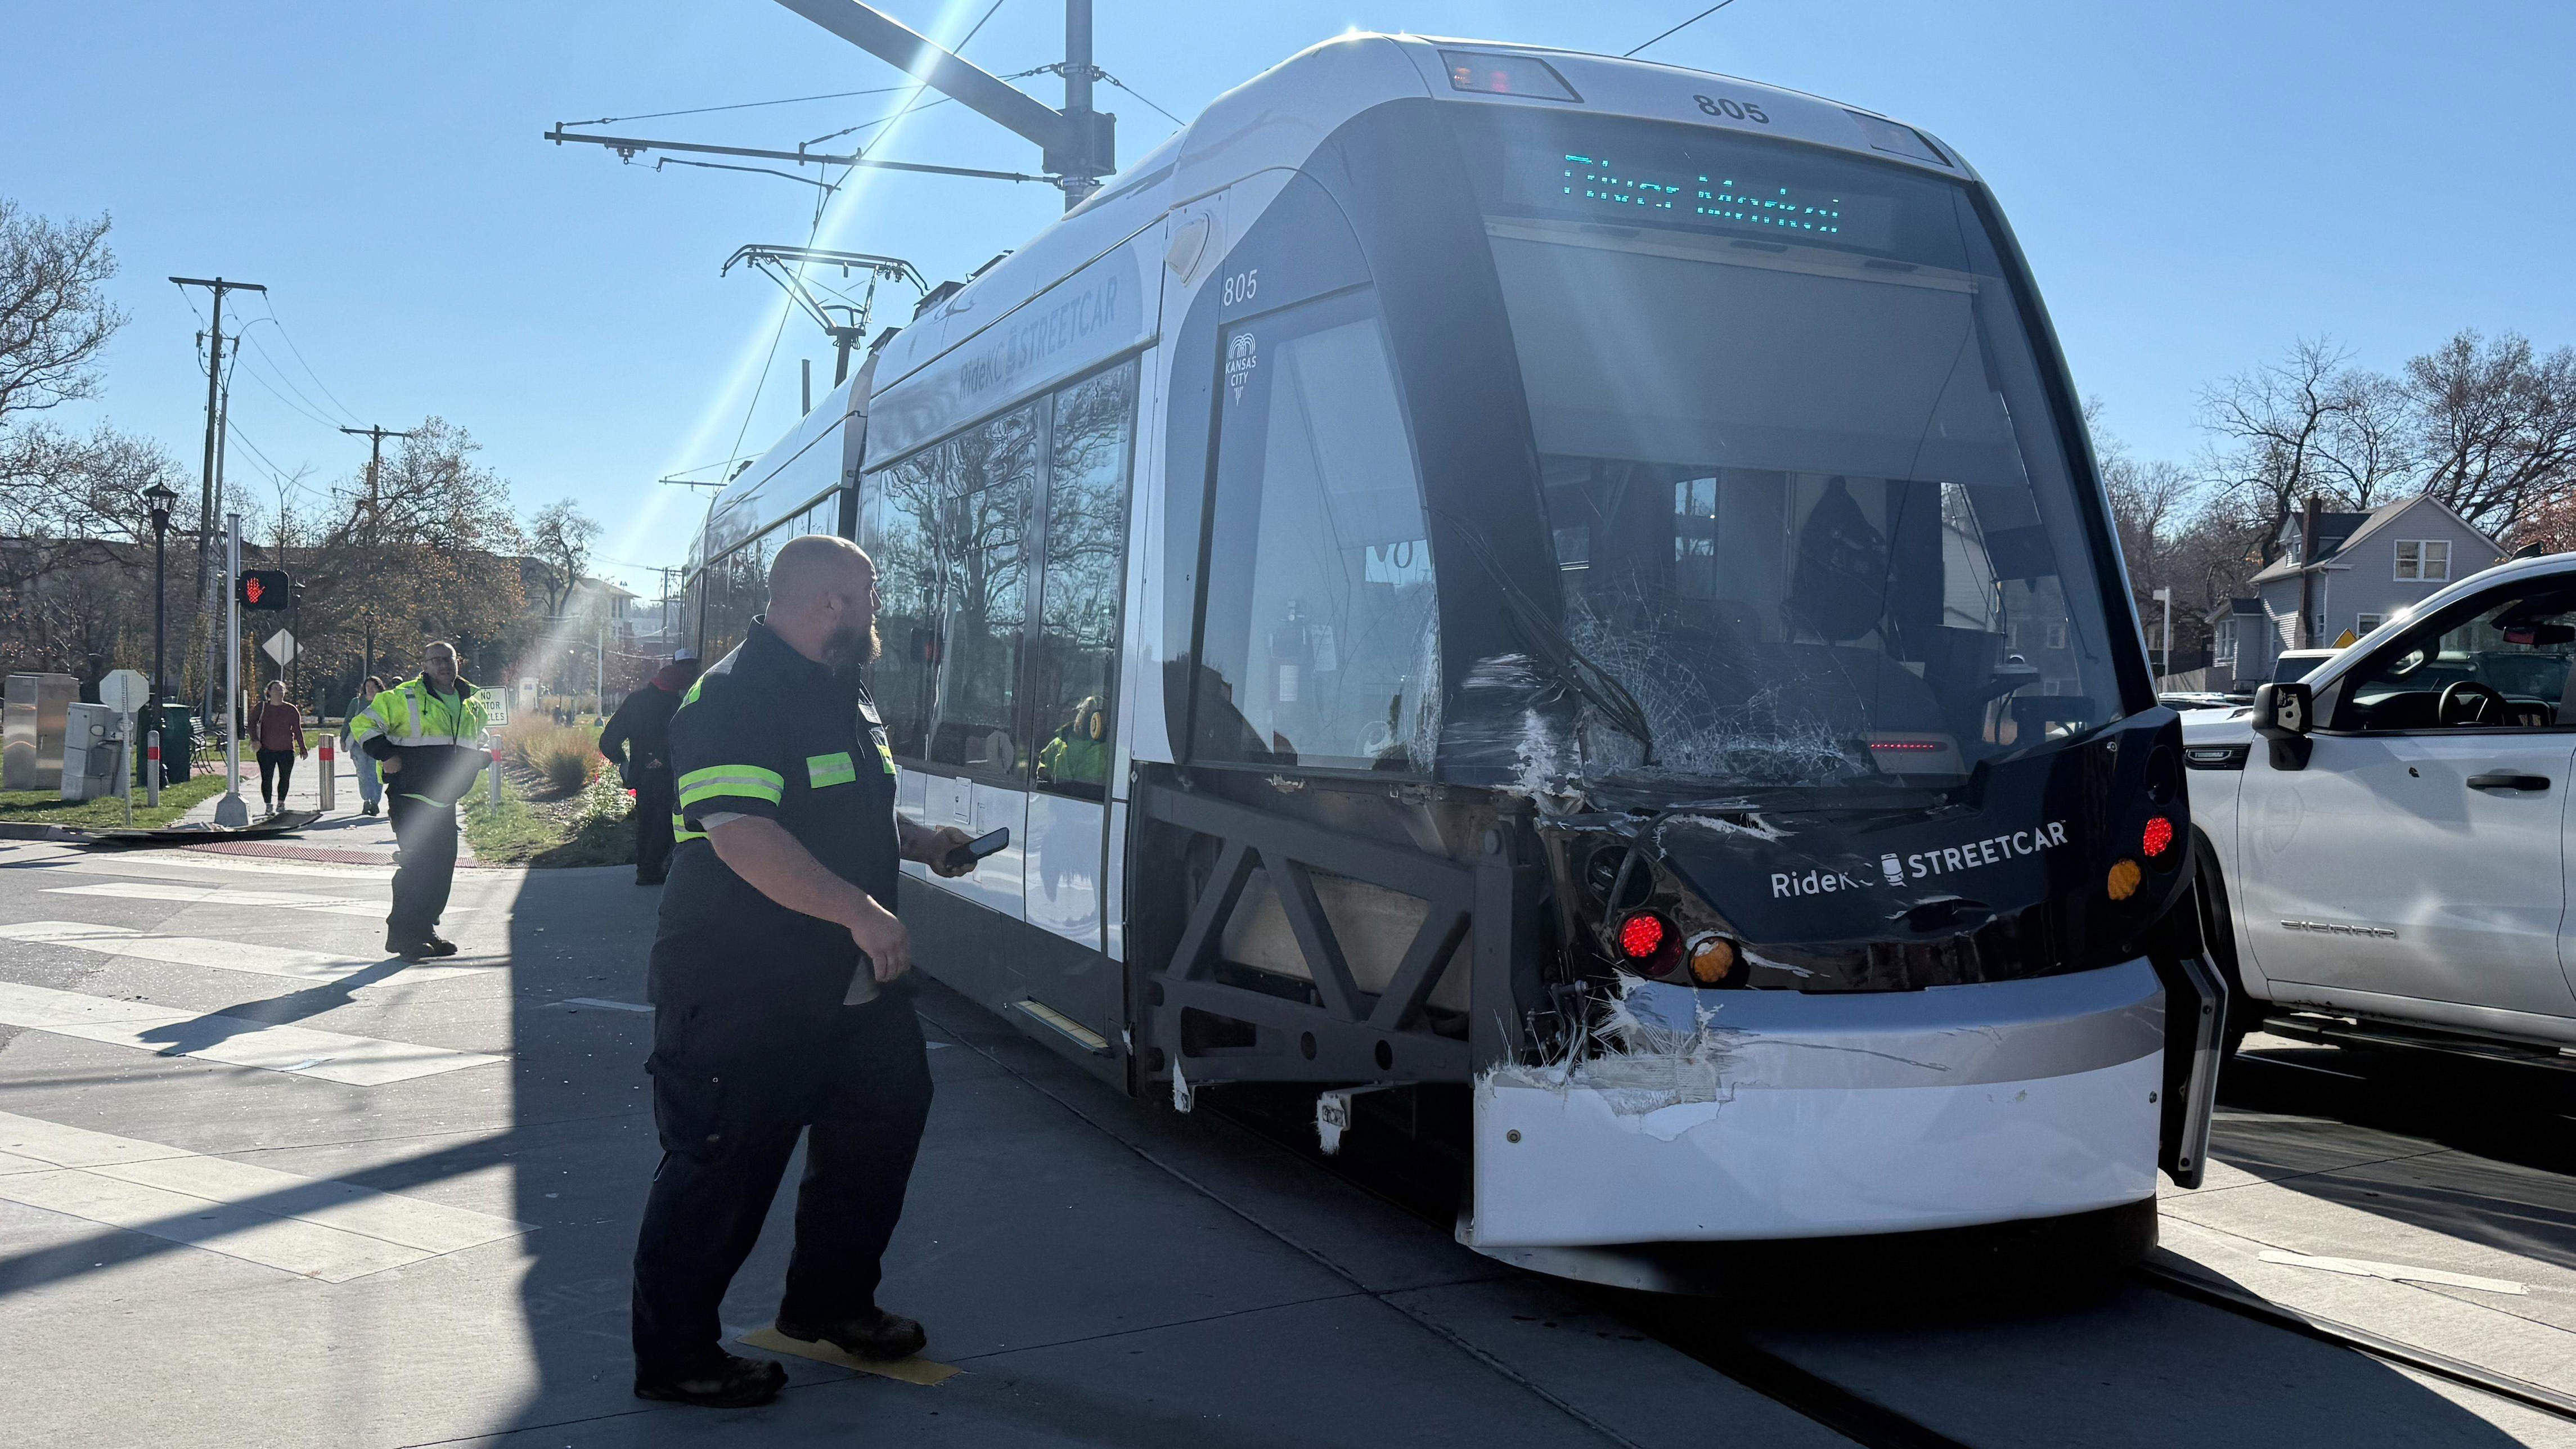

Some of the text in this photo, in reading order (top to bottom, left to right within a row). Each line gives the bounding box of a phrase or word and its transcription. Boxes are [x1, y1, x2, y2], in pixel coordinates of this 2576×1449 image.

[1693, 94, 1769, 124] 805
[1224, 269, 1257, 307] 805
[959, 275, 1118, 401] RideKC STREETCAR
[1225, 356, 1257, 375] KANSAS
[1231, 371, 1249, 386] CITY
[481, 691, 491, 700] NO
[482, 701, 500, 710] OTOR
[1908, 821, 2068, 878] STREETCAR
[2281, 919, 2399, 940] SIERRA
